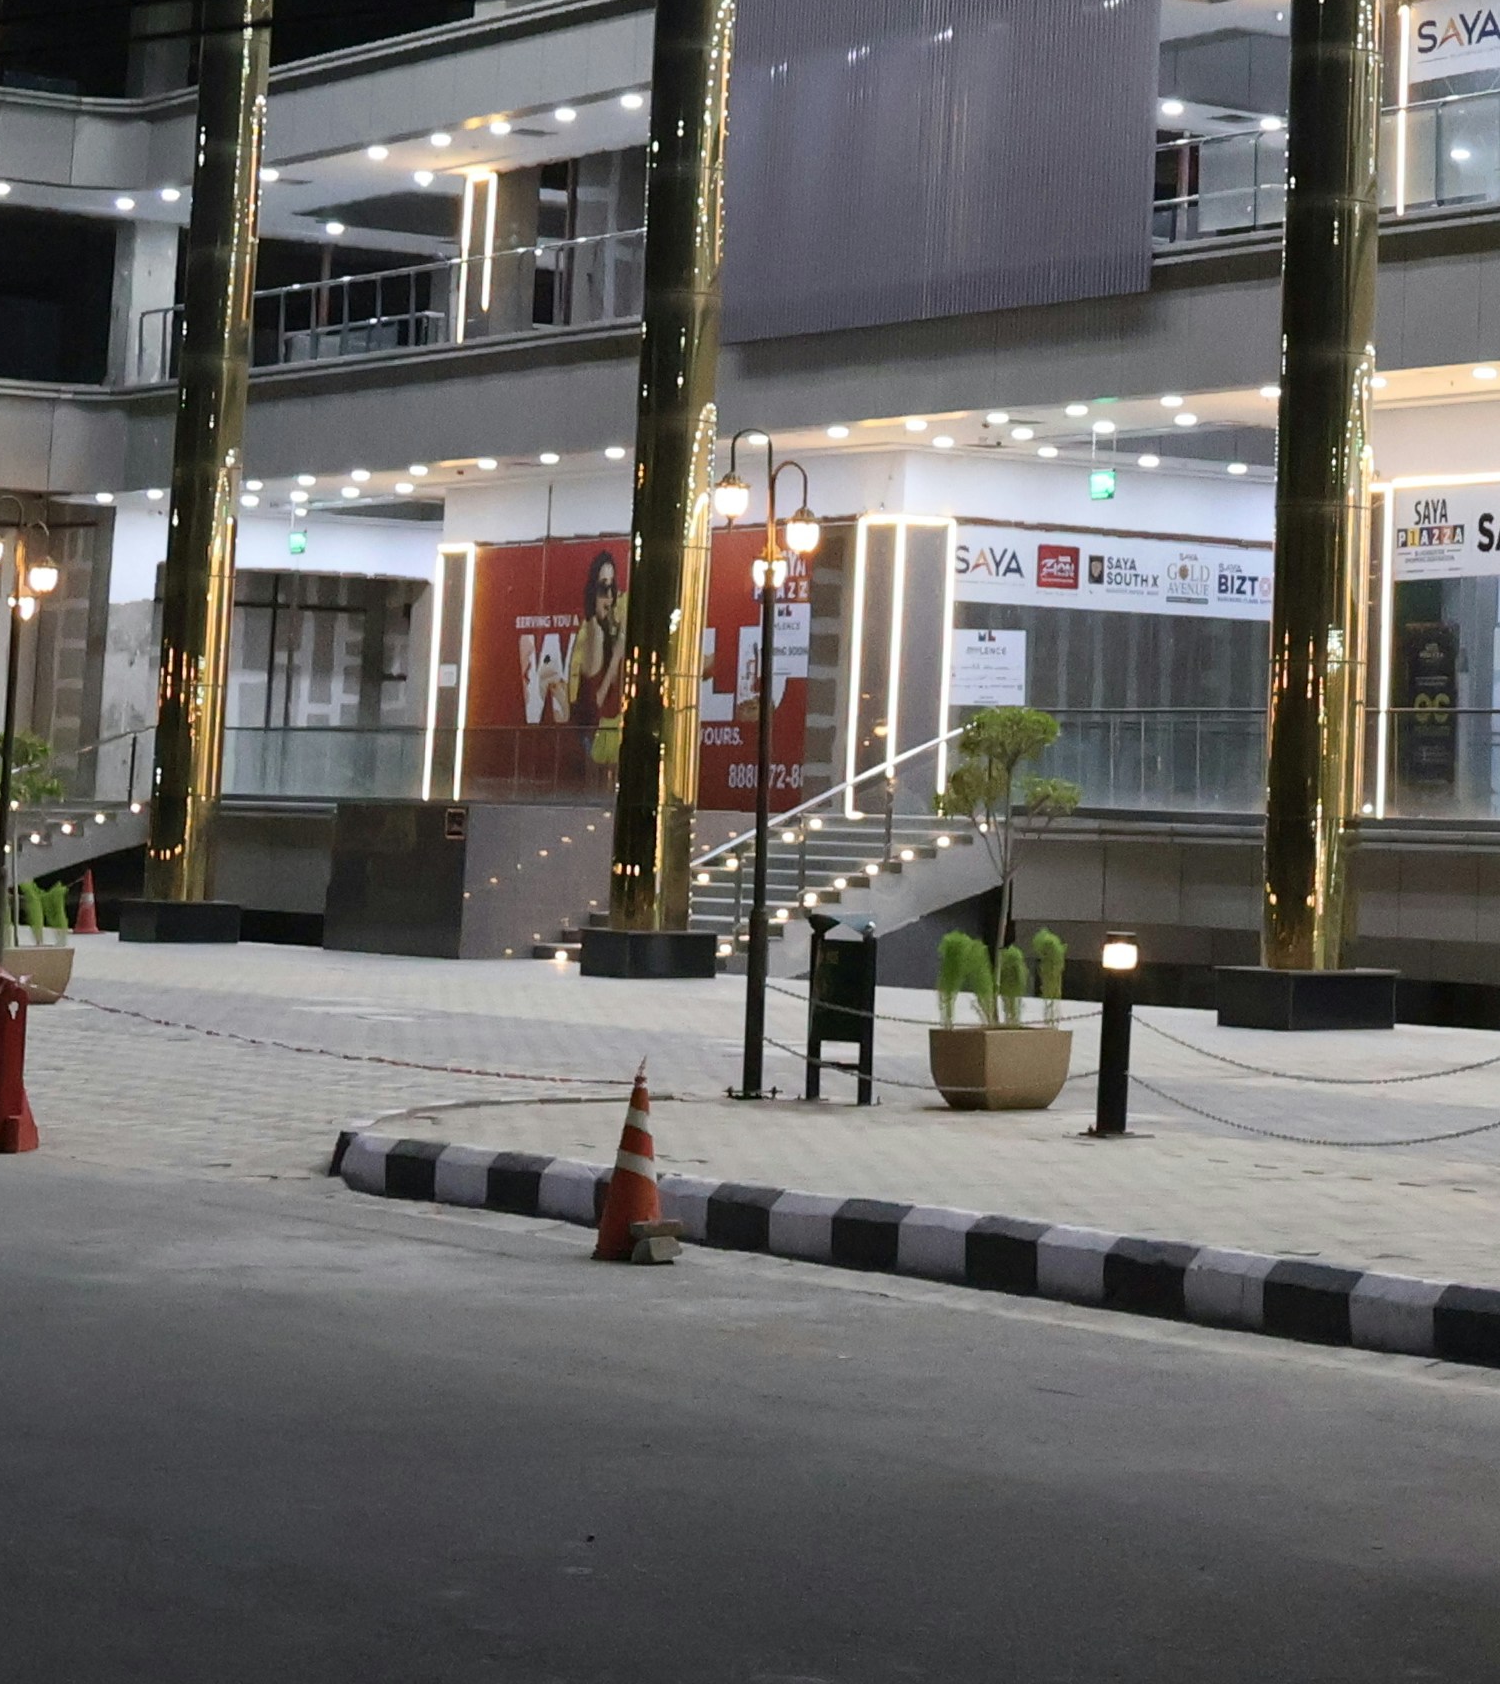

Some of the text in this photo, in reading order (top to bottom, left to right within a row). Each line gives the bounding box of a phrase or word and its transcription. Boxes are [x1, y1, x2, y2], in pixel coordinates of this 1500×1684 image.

[1414, 499, 1448, 525] SAYA
[1397, 524, 1464, 548] PIAZZA
[955, 545, 1026, 579] SAYA
[1106, 556, 1138, 571] SAYA
[1167, 562, 1211, 583] GOLD
[1106, 571, 1160, 588] SOUTH X
[1167, 582, 1210, 597] AVENUE
[1218, 574, 1272, 597] BIZTO
[552, 614, 572, 627] YOU
[572, 614, 580, 626] A
